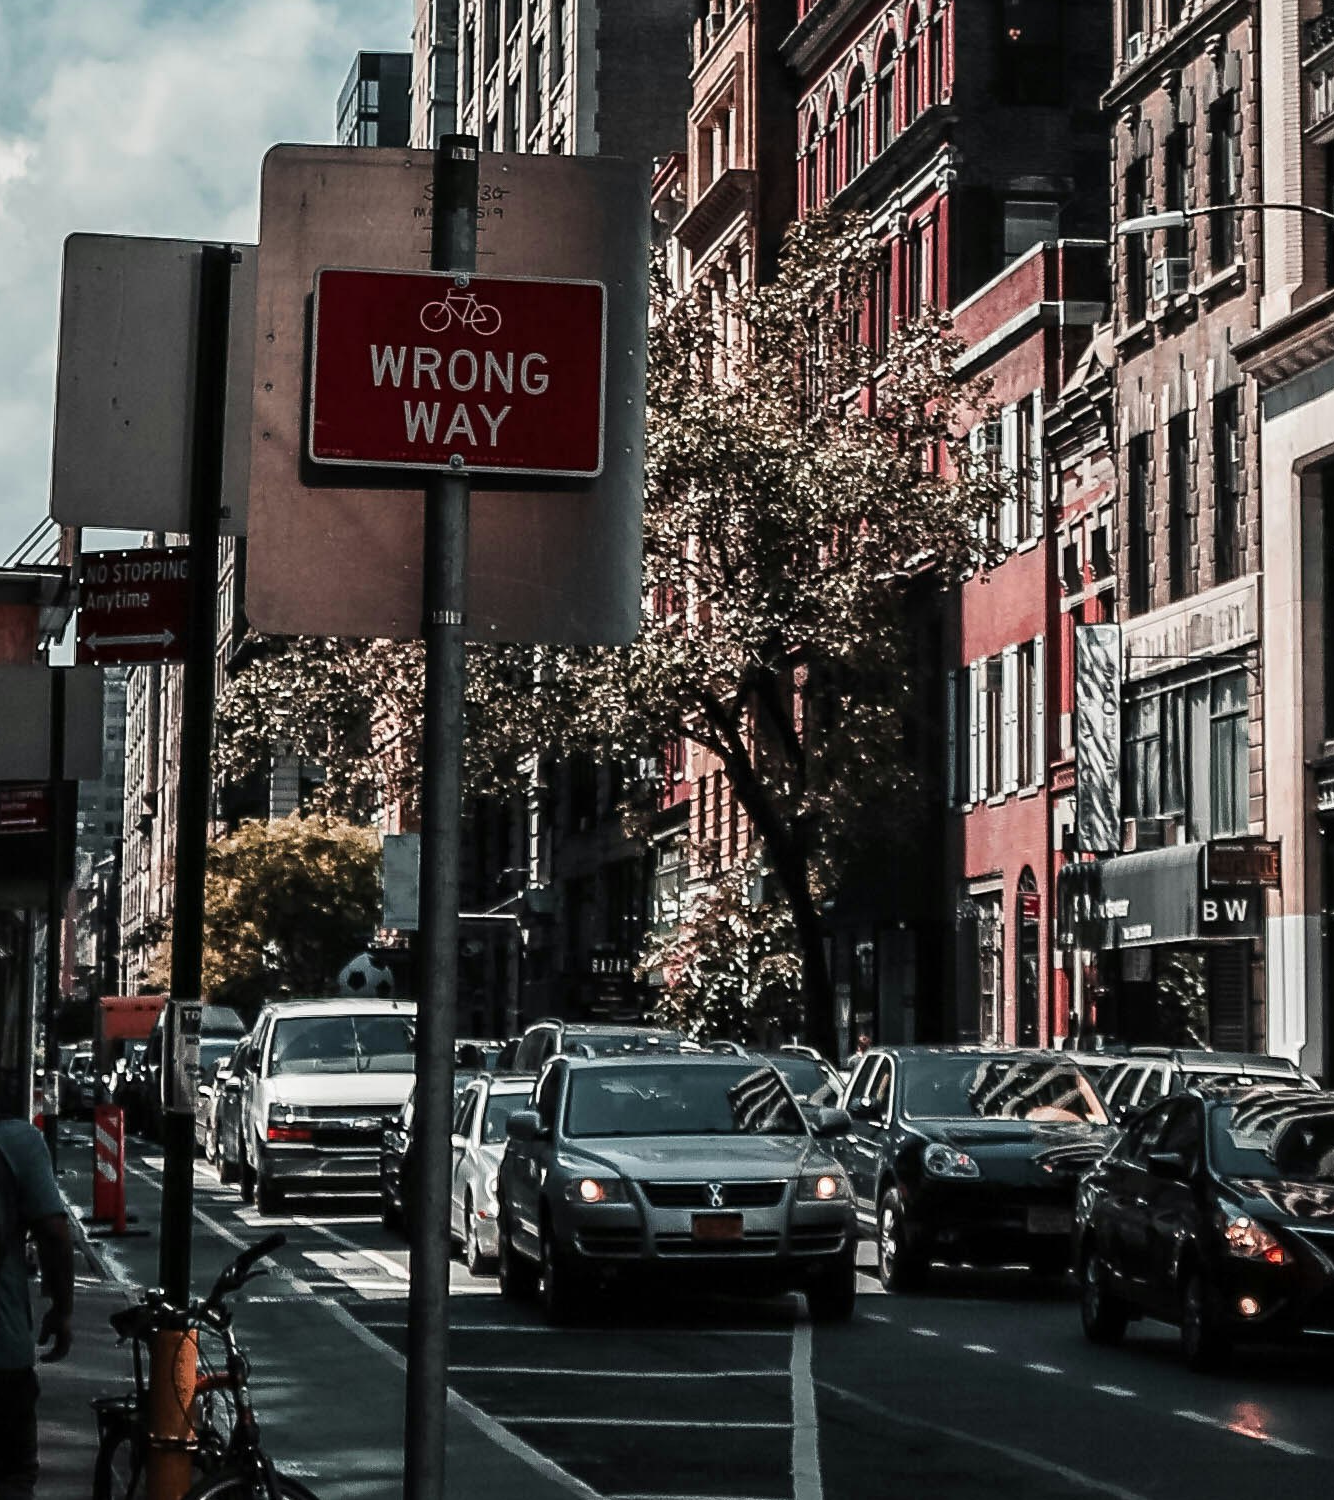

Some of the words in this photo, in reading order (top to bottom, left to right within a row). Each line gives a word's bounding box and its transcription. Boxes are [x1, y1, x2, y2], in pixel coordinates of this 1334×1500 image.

[369, 343, 550, 396] WRONG
[403, 399, 513, 448] WAY
[86, 563, 108, 584] NO
[111, 559, 189, 583] STOPPING
[85, 589, 150, 615] Anytime
